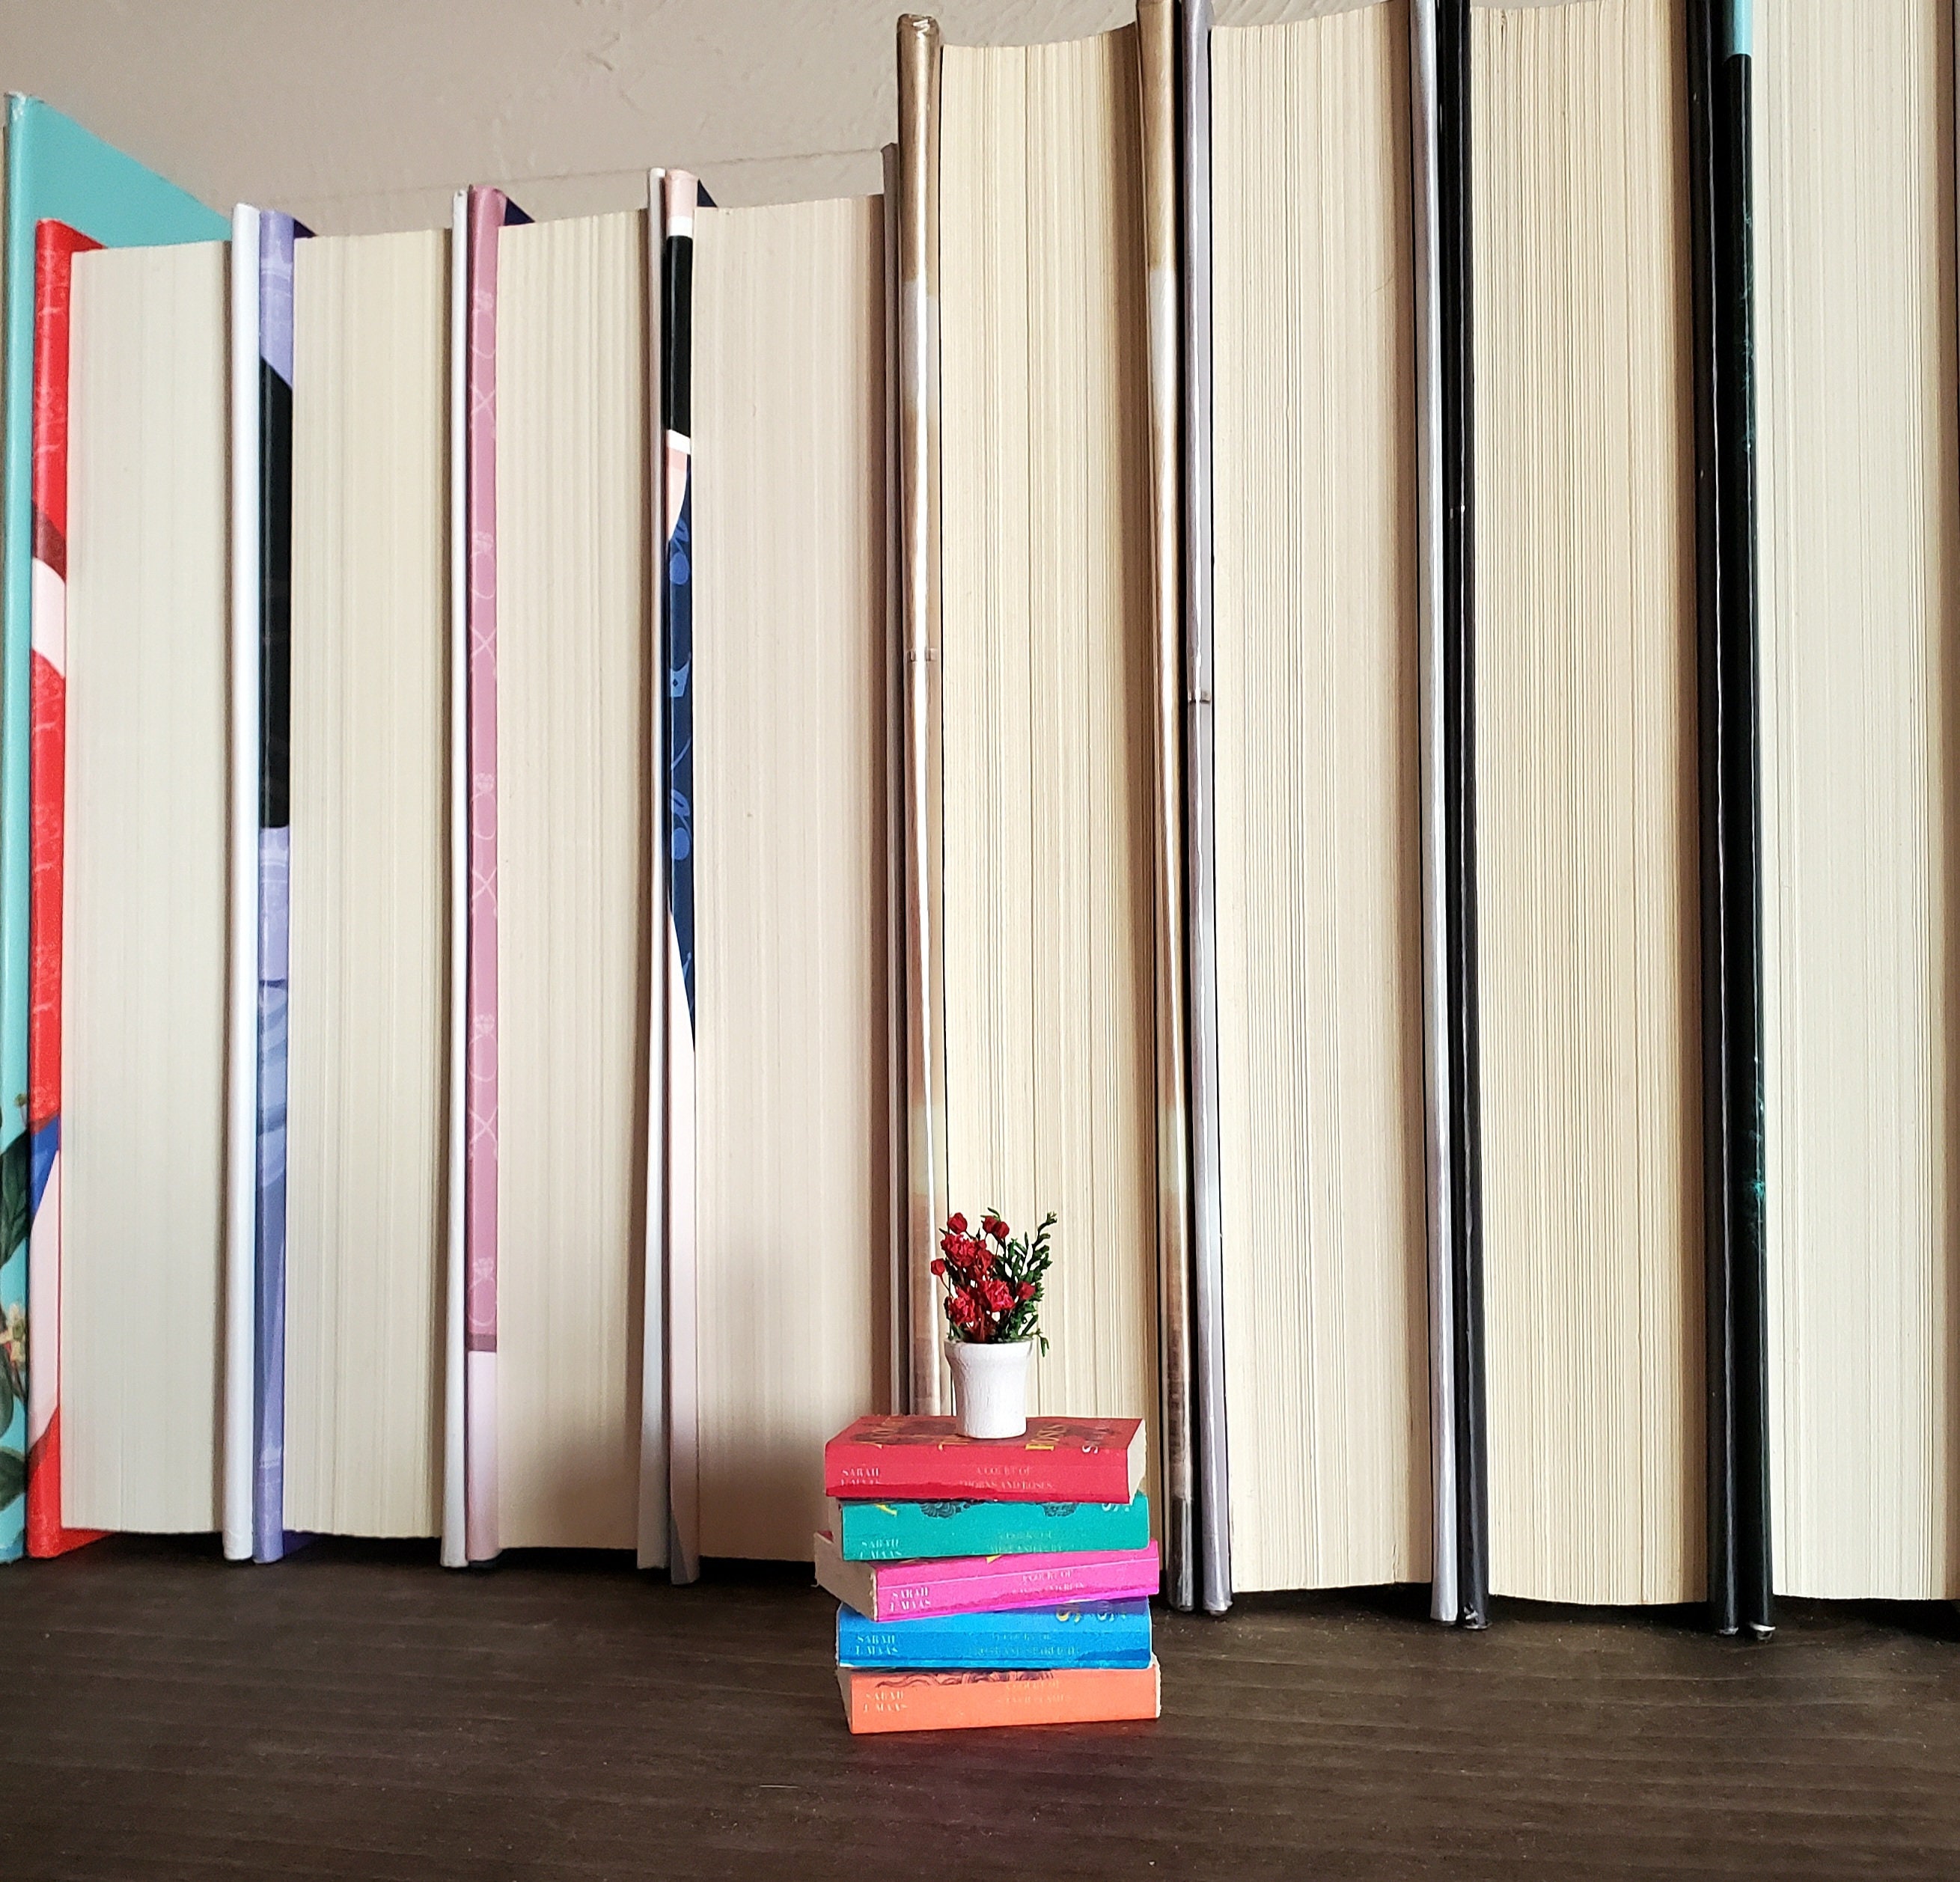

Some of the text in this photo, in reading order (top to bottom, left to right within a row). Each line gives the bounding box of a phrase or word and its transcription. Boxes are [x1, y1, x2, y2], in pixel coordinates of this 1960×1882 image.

[842, 1467, 880, 1477] SARAH
[892, 1586, 928, 1600] SARAH
[857, 1635, 896, 1644] SARAH
